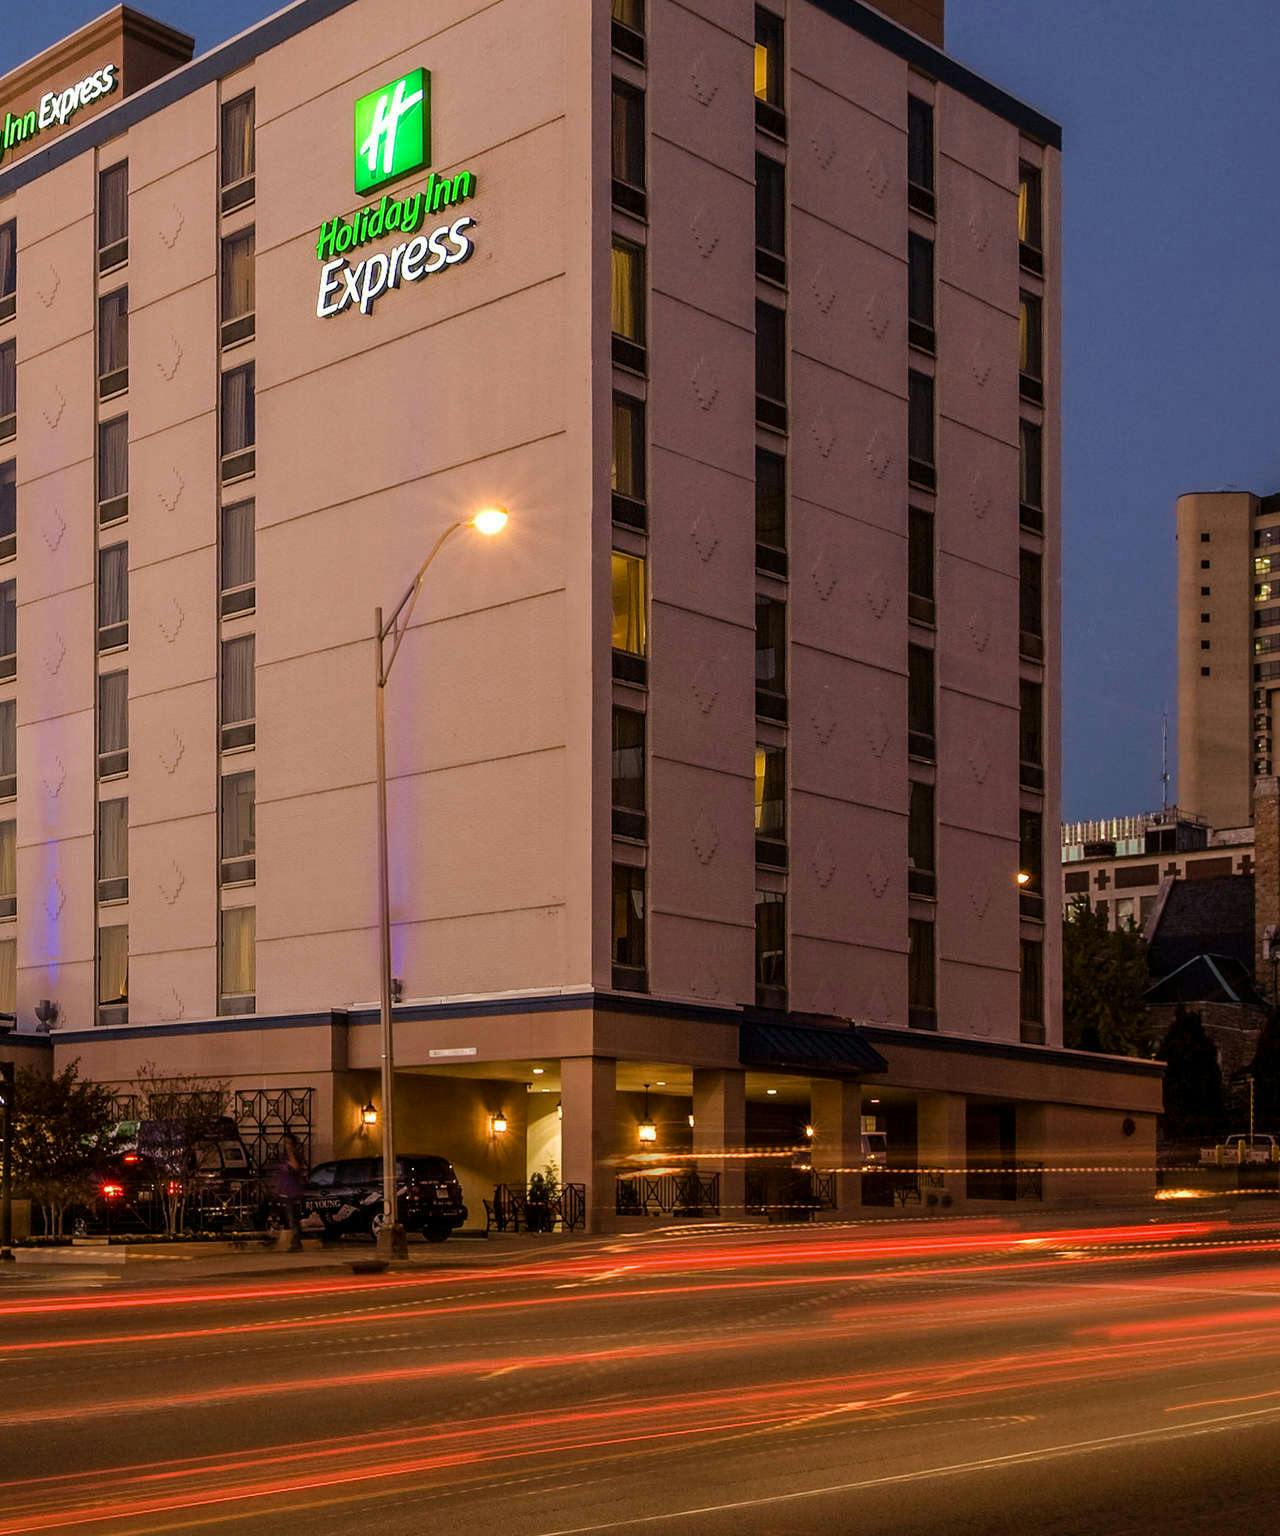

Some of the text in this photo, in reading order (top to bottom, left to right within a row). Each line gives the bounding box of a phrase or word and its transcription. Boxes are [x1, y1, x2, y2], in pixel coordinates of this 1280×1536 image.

[3, 111, 37, 149] Inn
[37, 63, 118, 129] Express
[316, 169, 473, 260] Holiday Inn
[316, 216, 473, 318] Express
[314, 1199, 341, 1209] YOUNG
